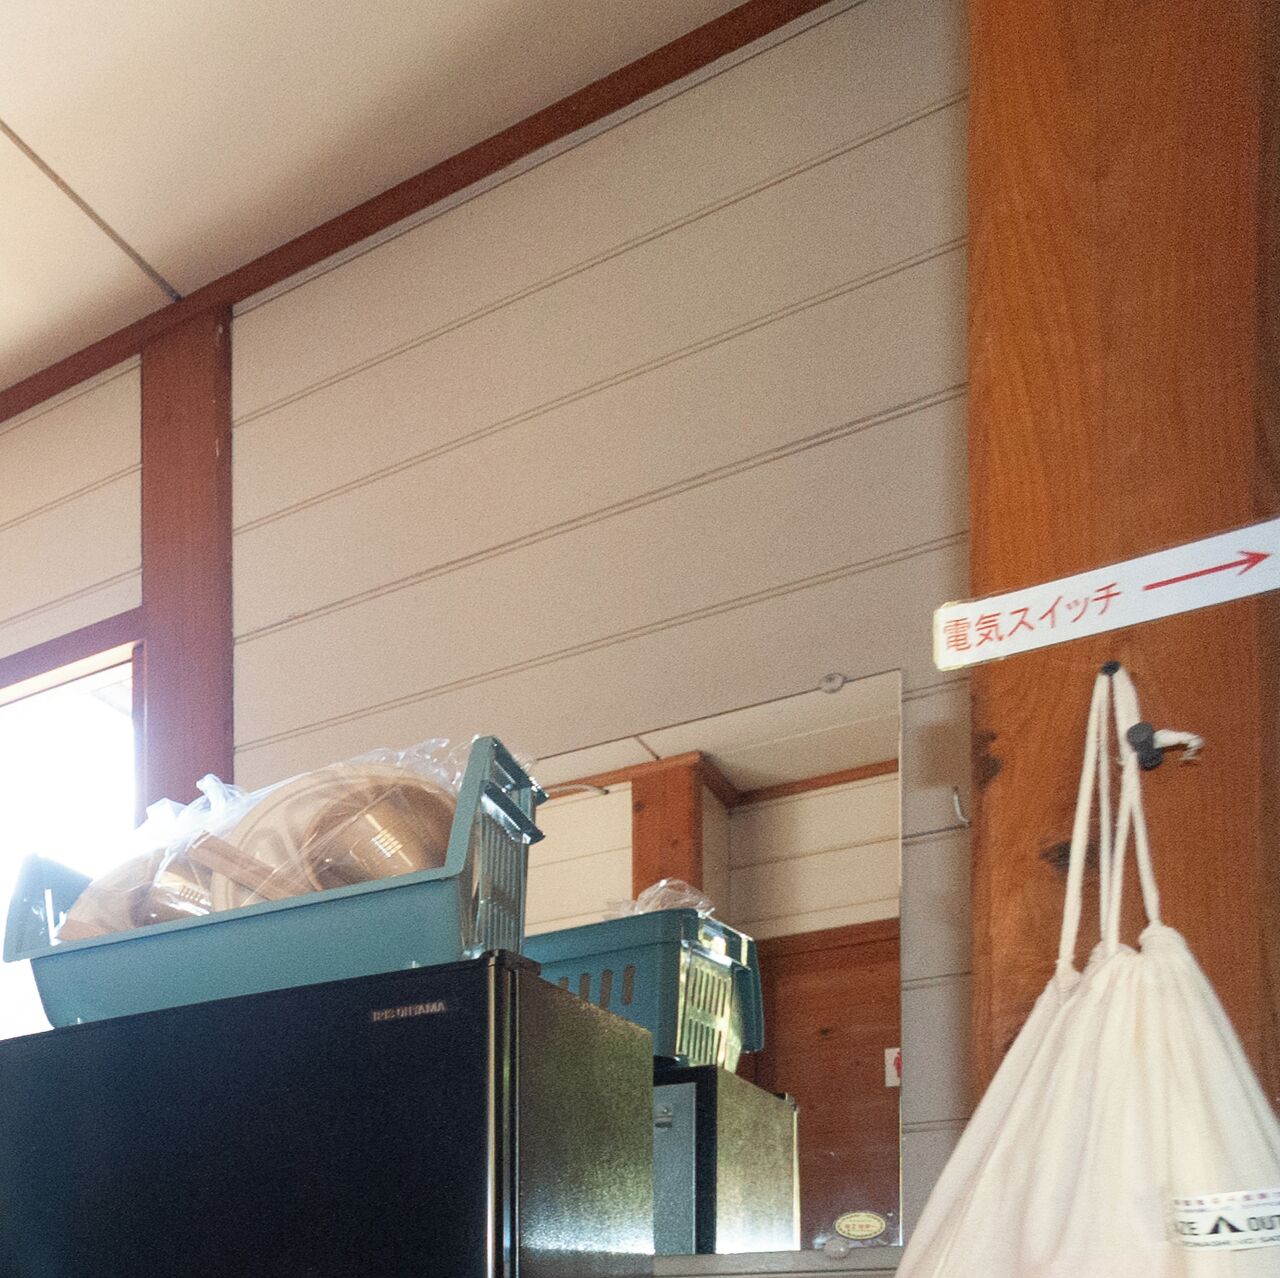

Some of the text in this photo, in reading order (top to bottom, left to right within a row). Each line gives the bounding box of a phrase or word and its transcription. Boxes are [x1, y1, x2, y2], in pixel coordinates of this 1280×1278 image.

[943, 582, 1122, 652] 電気スイッチ
